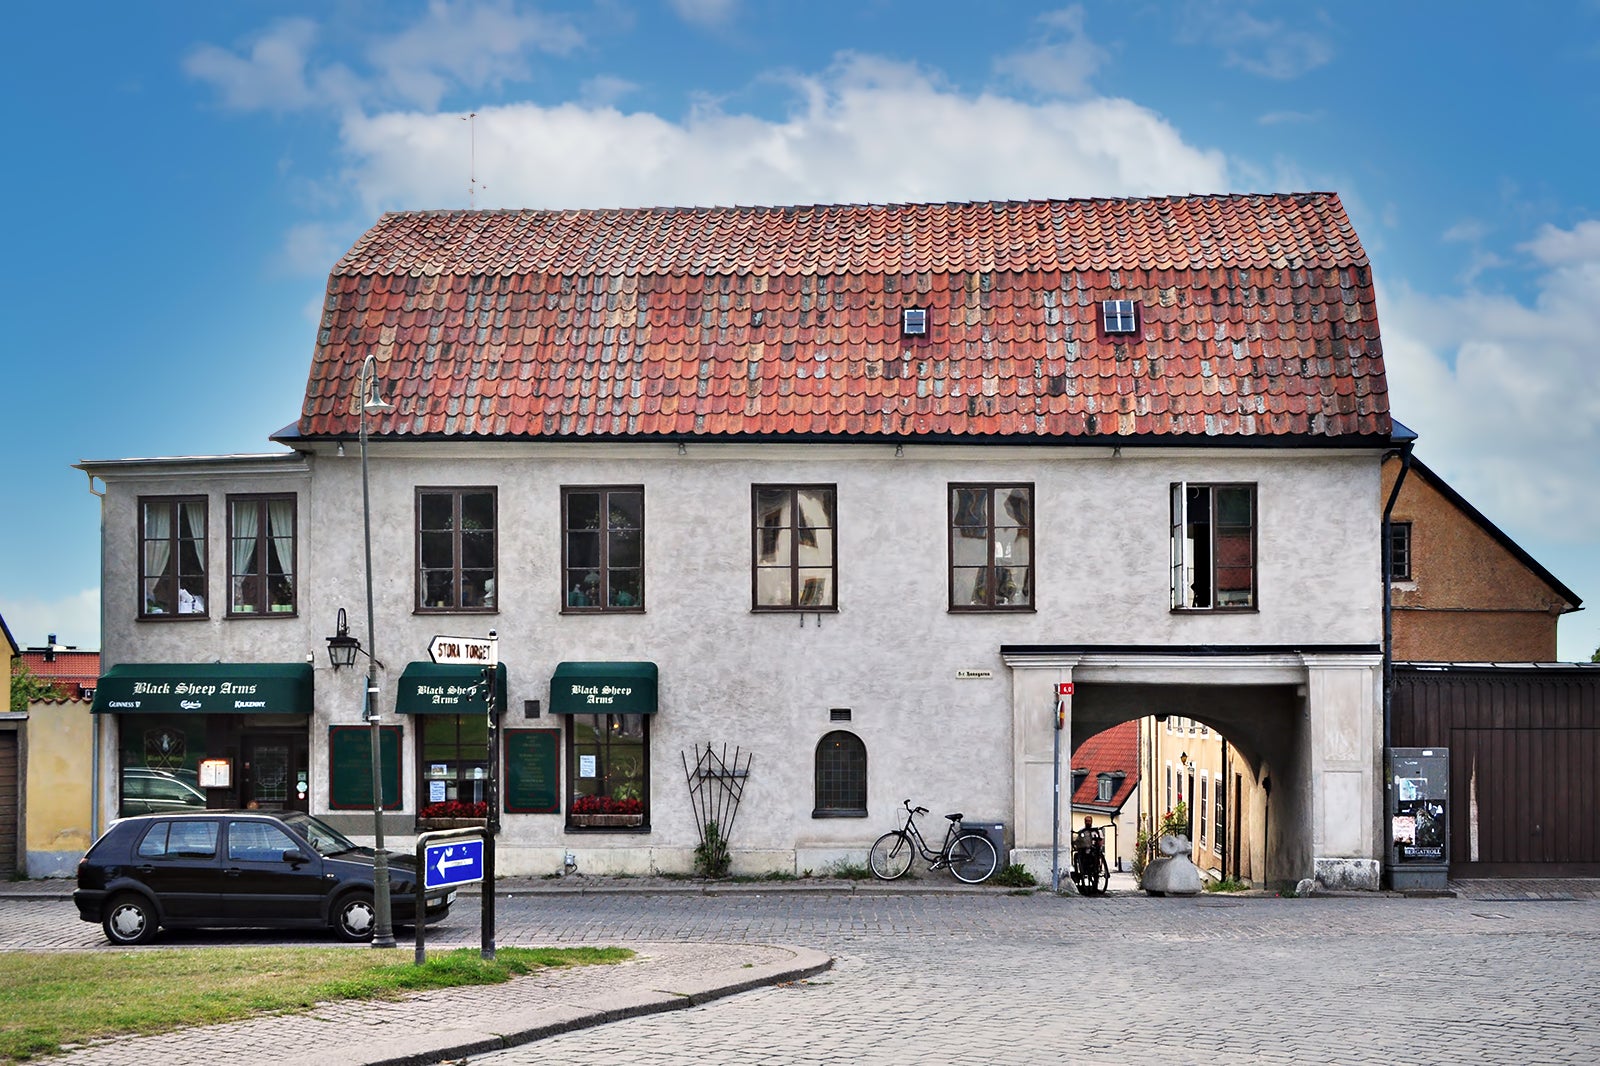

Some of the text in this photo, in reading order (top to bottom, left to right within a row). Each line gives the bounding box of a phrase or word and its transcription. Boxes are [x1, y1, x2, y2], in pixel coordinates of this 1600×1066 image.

[438, 643, 490, 660] STORA TORGET
[132, 682, 257, 696] Black Sheep Arms
[417, 685, 477, 697] Black Shep
[571, 684, 632, 696] Black Sheep
[432, 695, 459, 704] Arms
[586, 694, 614, 704] Arms
